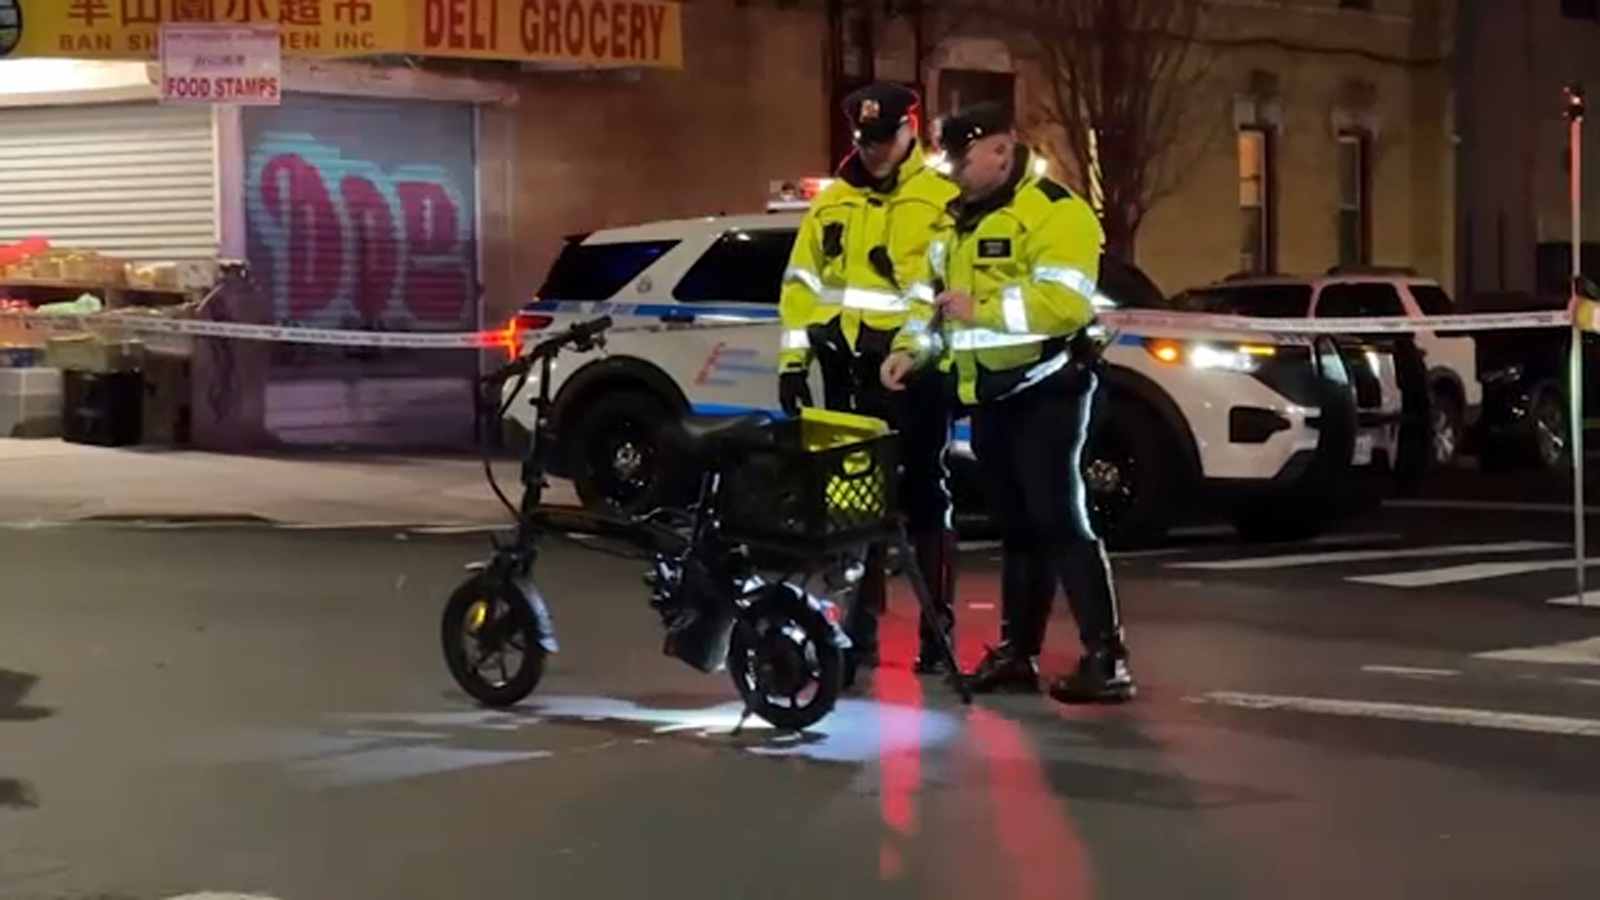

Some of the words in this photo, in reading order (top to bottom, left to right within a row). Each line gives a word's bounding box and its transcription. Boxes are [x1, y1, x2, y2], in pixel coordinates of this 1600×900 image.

[423, 0, 498, 50] DELI
[519, 0, 666, 60] GROCERY
[58, 34, 112, 51] BAN
[167, 76, 211, 98] FOOD
[214, 76, 278, 98] STAMPS
